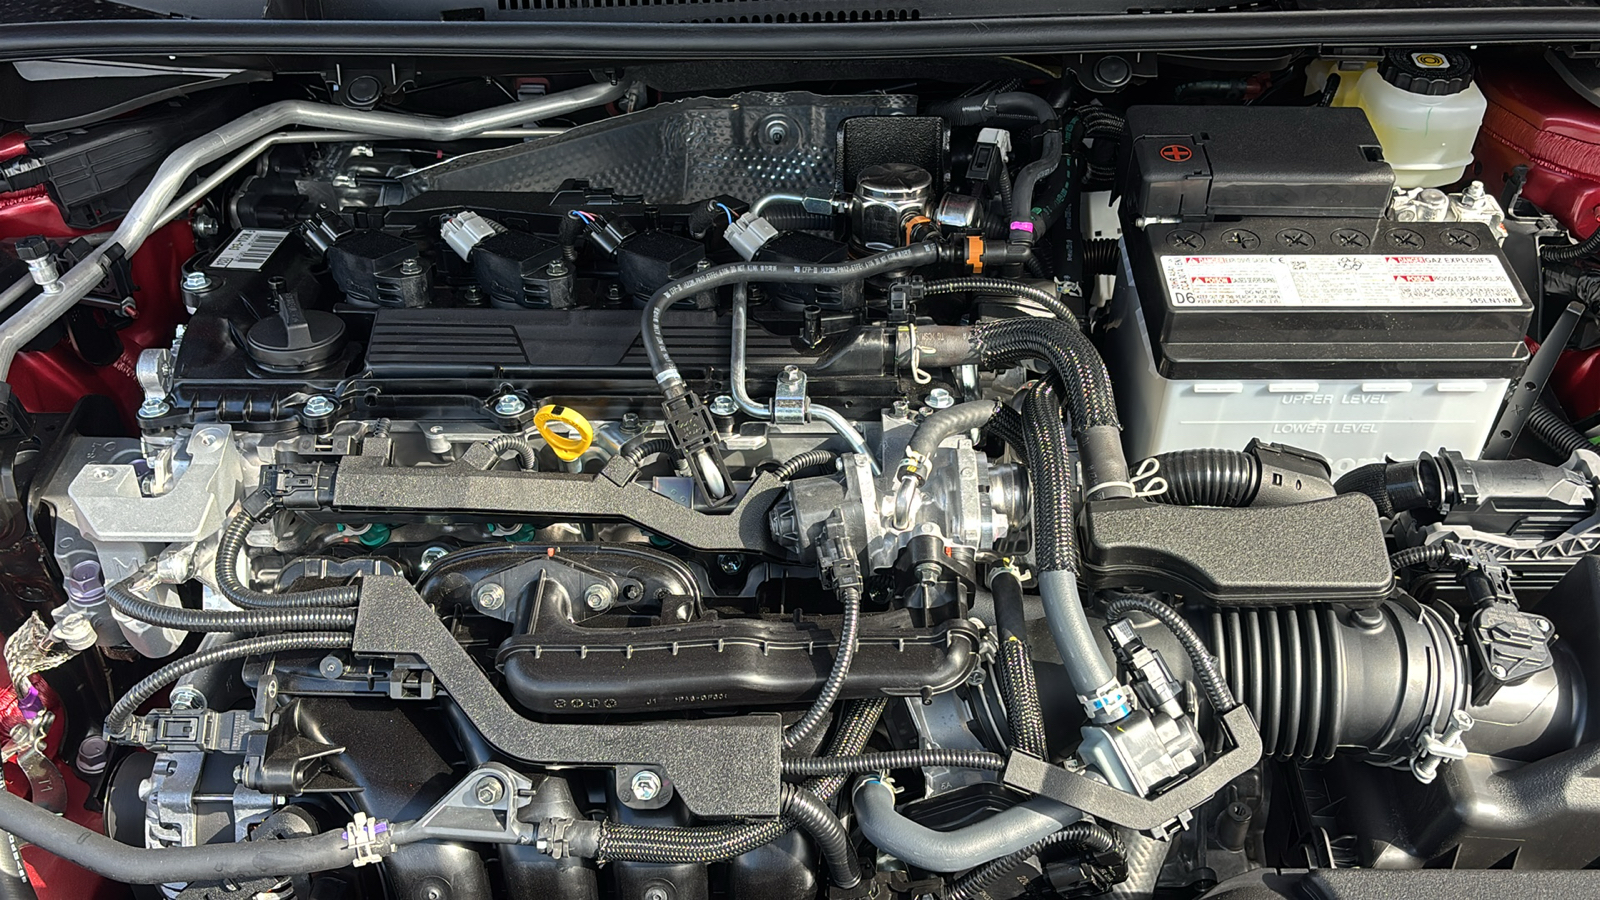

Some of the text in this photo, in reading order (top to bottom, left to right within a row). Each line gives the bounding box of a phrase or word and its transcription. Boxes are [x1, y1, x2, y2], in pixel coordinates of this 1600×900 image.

[1175, 292, 1196, 304] D6
[1281, 393, 1389, 405] UPPER LEVEL
[1273, 423, 1379, 434] LOWER LEVEL
